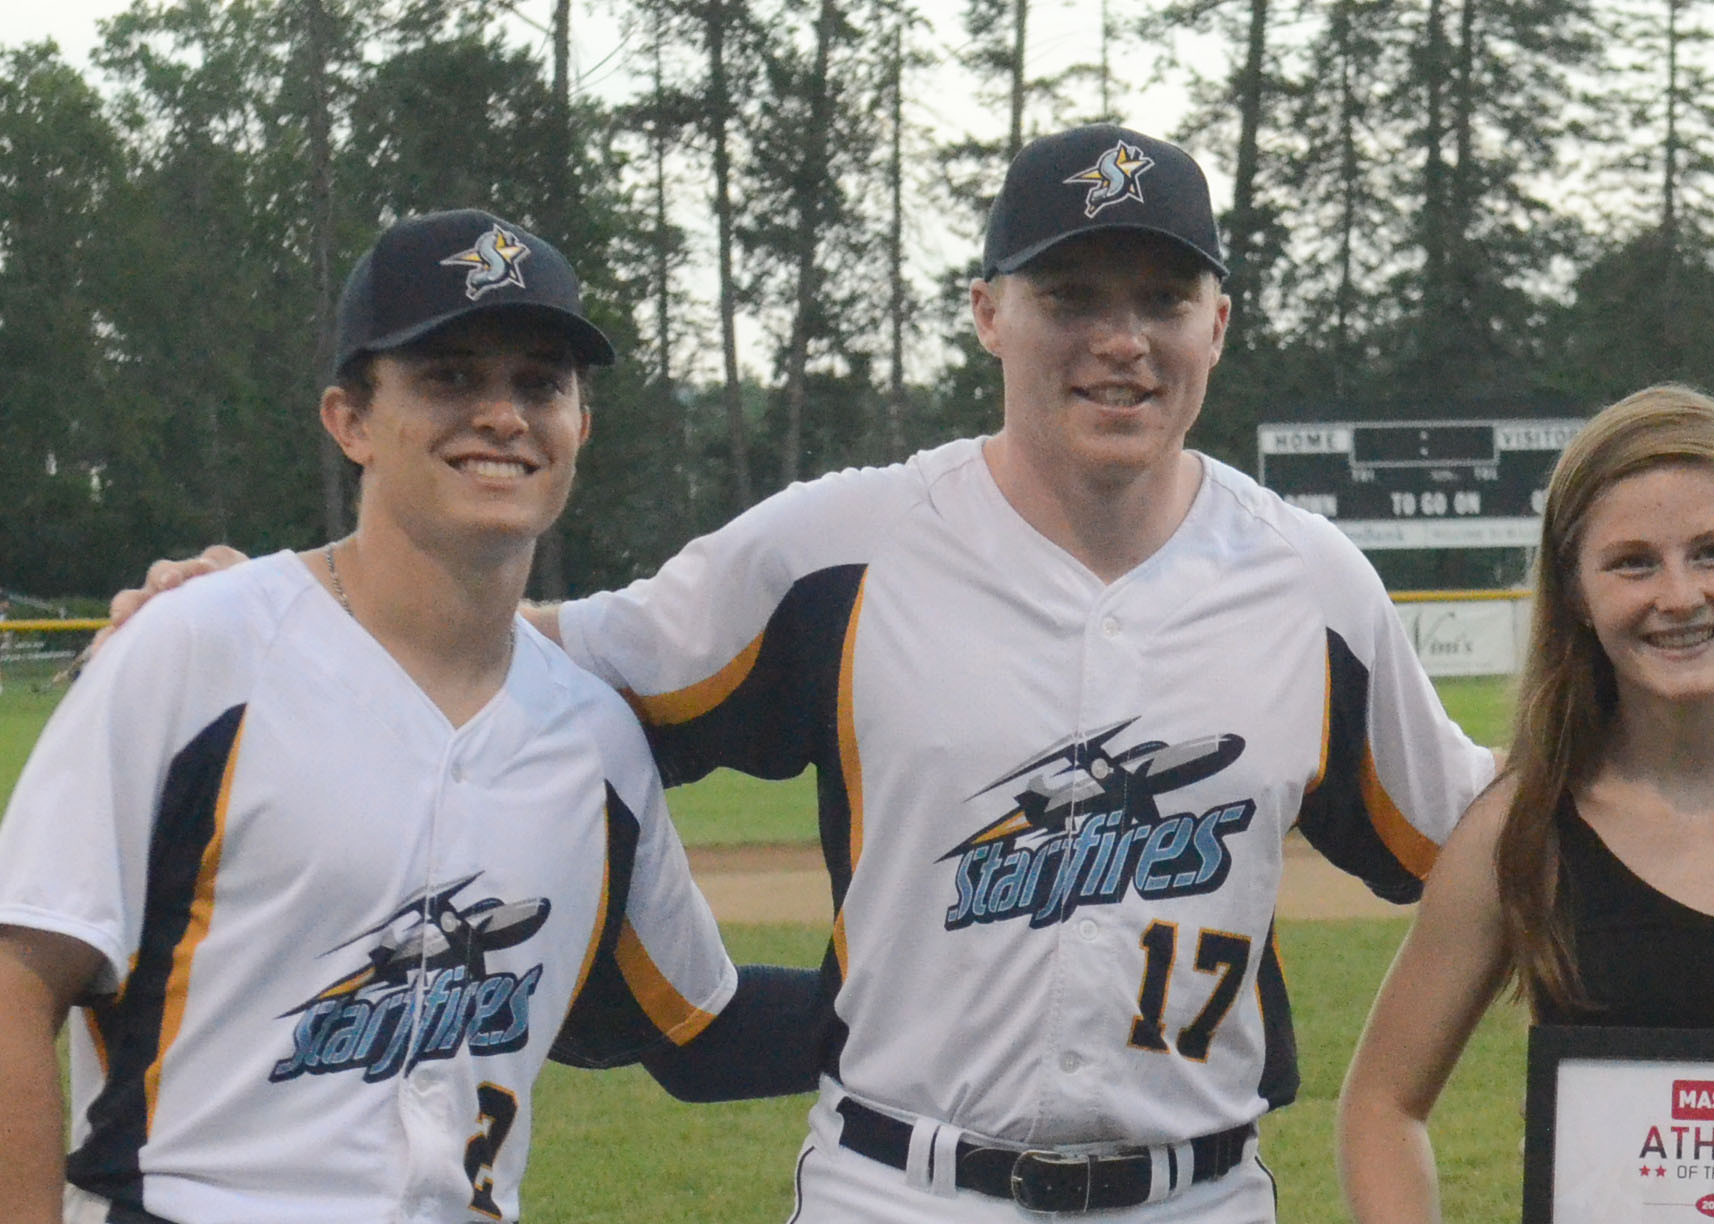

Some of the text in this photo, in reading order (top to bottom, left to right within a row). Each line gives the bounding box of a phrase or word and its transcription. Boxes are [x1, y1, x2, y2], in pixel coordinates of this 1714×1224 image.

[1274, 431, 1335, 448] HOME
[1501, 430, 1580, 446] VISITO
[944, 798, 1257, 931] Starfires
[1126, 917, 1252, 1064] 17
[464, 1080, 519, 1221] 2
[1677, 1165, 1699, 1180] OF
